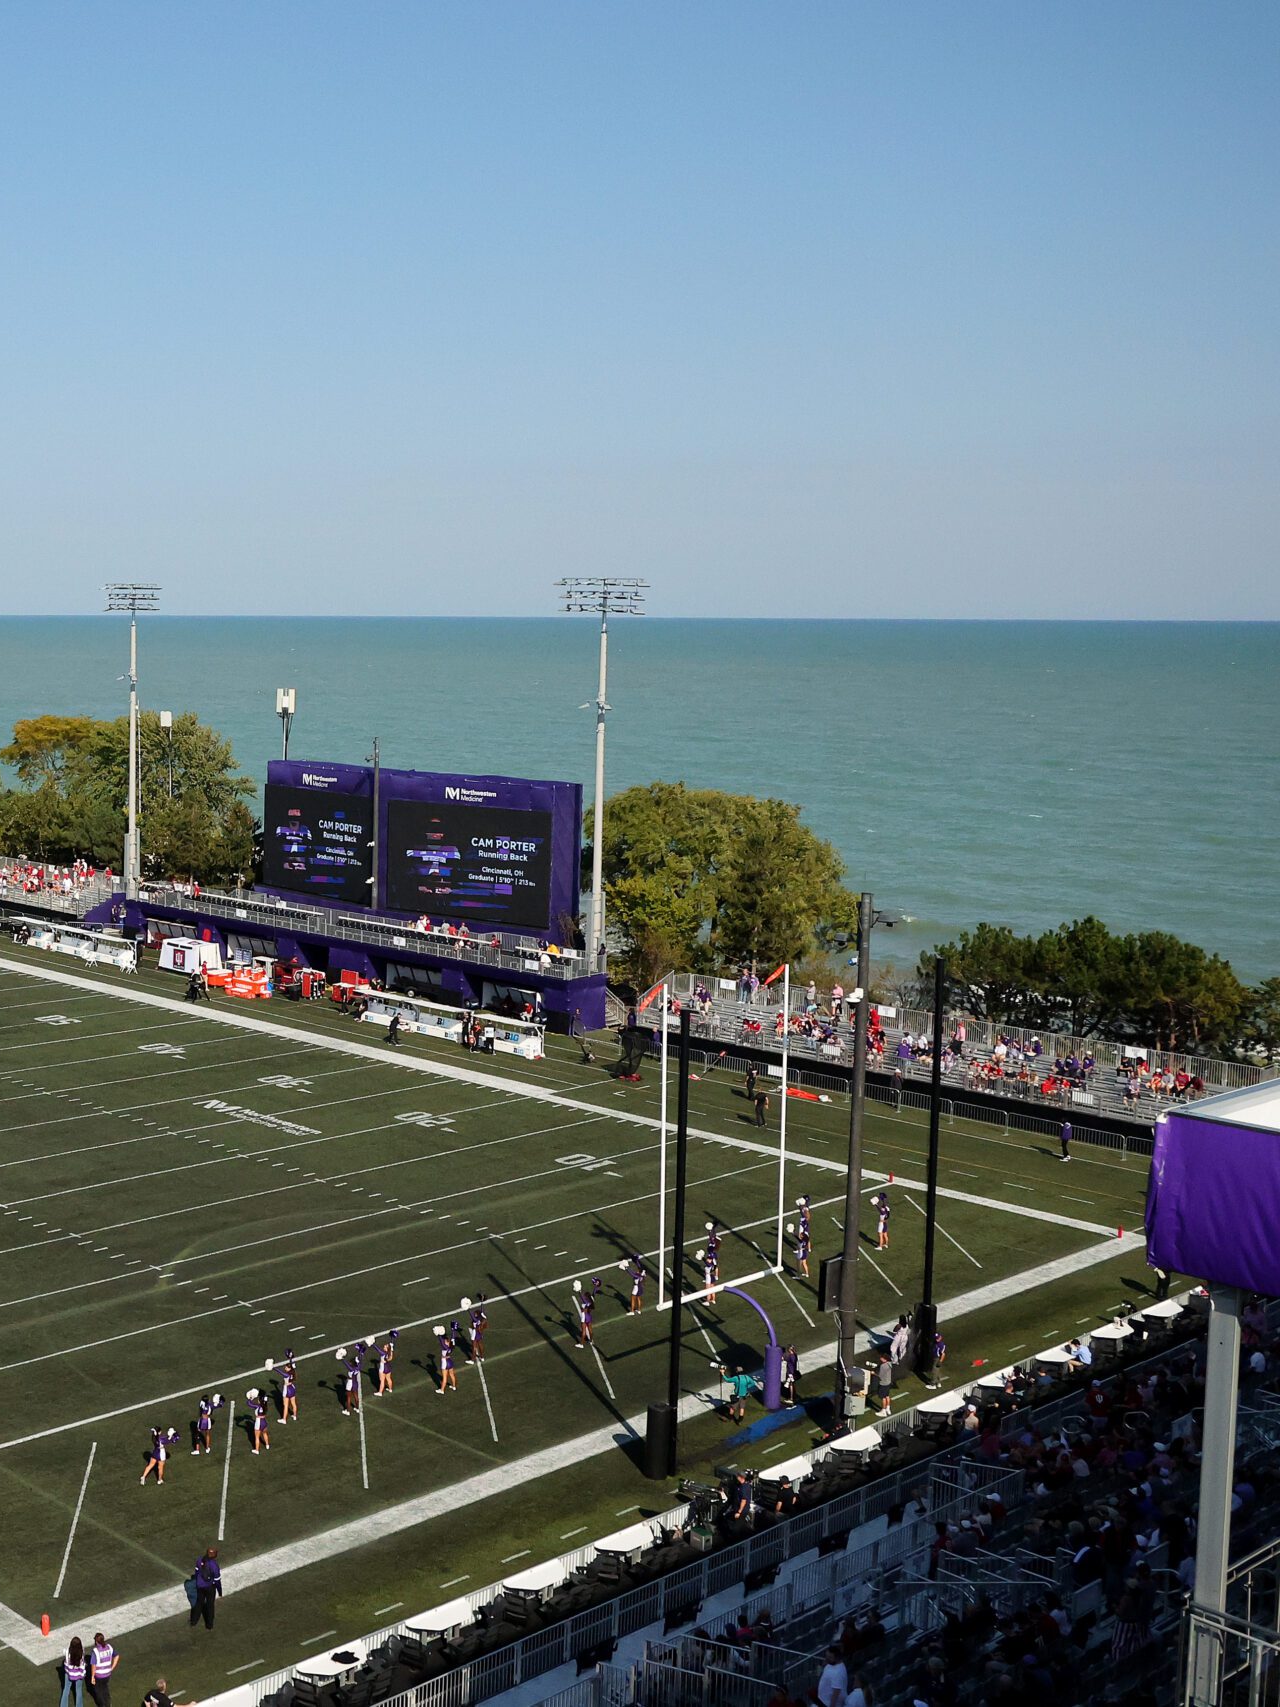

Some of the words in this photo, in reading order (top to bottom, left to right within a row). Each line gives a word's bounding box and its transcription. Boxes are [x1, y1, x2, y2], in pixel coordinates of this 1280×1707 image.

[461, 788, 497, 798] Northwestern
[318, 820, 334, 830] CAM
[335, 822, 363, 834] PORTER
[323, 831, 344, 842] Running
[344, 834, 357, 843] Back
[471, 837, 494, 849] CAM
[496, 839, 537, 853] PORTER
[478, 850, 509, 861] Running
[509, 853, 529, 862] Back
[468, 873, 495, 883] Graduate
[518, 878, 529, 886] 213
[514, 869, 524, 877] OH
[393, 1111, 456, 1128] 20
[554, 1153, 617, 1171] 10
